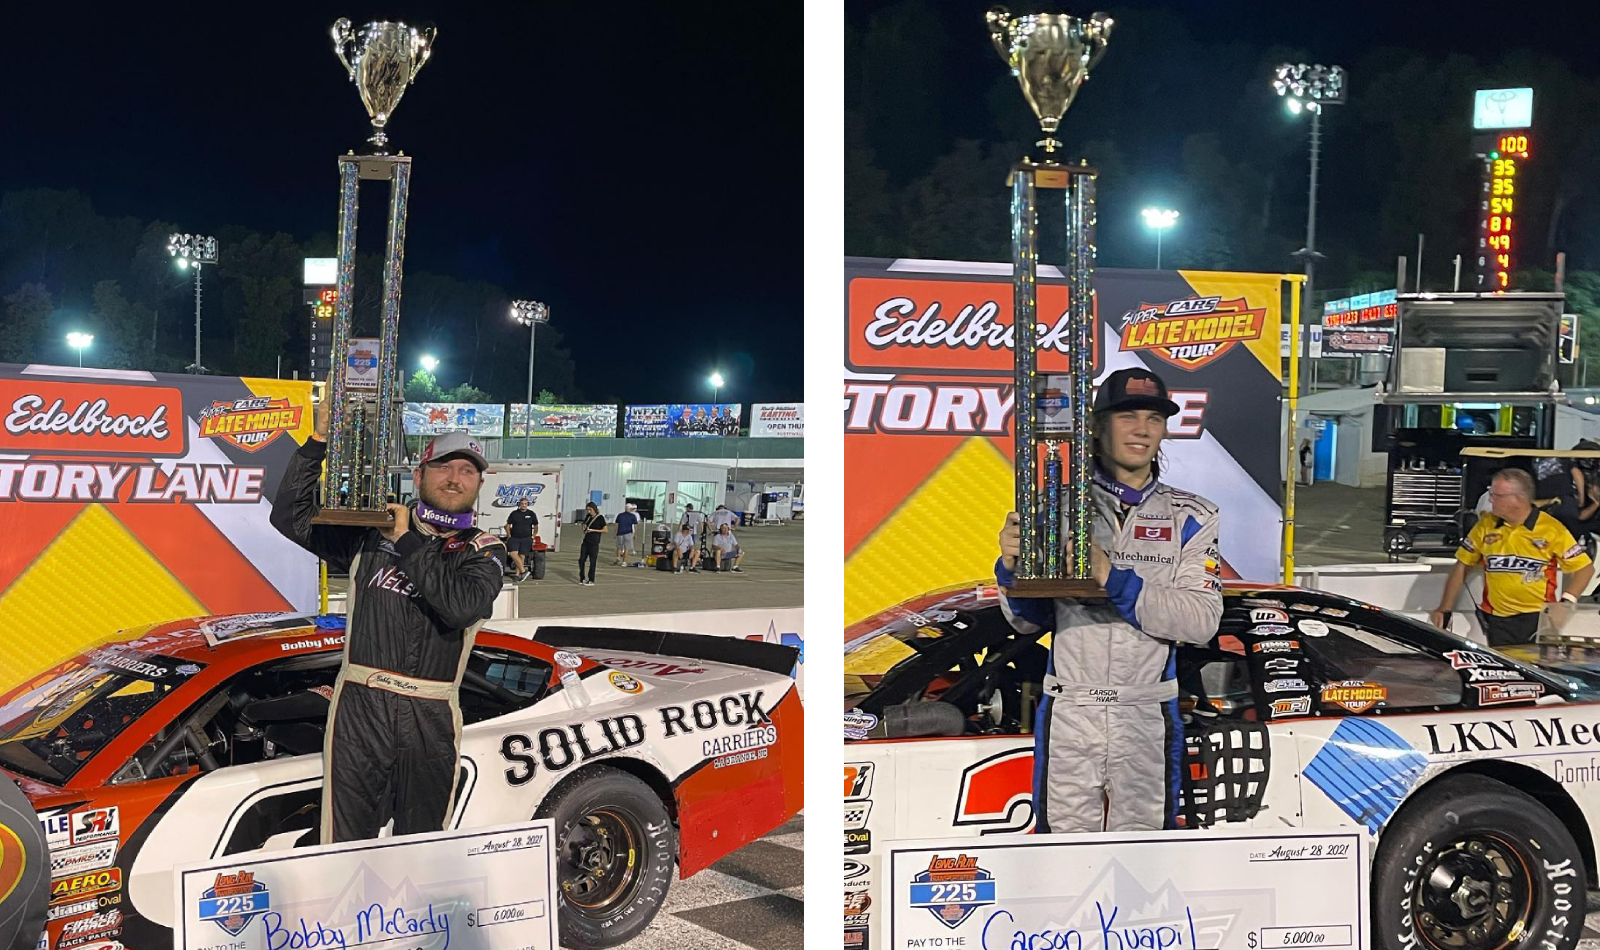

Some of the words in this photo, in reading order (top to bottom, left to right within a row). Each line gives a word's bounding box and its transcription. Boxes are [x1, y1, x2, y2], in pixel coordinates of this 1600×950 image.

[1501, 137, 1527, 153] 100
[1494, 160, 1515, 176] 35
[1493, 179, 1514, 195] 35
[1491, 198, 1513, 214] 54
[1490, 216, 1512, 232] 81
[1489, 235, 1510, 250] 49
[1498, 254, 1509, 268] 4
[1498, 271, 1508, 287] 7
[318, 306, 333, 318] 22
[1119, 307, 1160, 330] SUPER
[1127, 319, 1185, 348] LATE
[1183, 313, 1257, 342] MODEL
[1169, 343, 1216, 360] TOUR
[843, 384, 1014, 432] TORY
[4, 394, 169, 440] Edelbrock
[205, 414, 245, 435] LATE
[245, 410, 297, 431] MODEL
[236, 431, 269, 444] TOUR
[133, 467, 265, 501] LANE
[497, 484, 542, 497] MTP
[422, 508, 458, 525] Hoosier
[1114, 551, 1175, 565] Mechanical
[281, 639, 322, 651] Bobby
[1467, 669, 1521, 681] XTREME
[1089, 688, 1119, 697] CARSON
[1325, 690, 1350, 701] LATE
[1350, 689, 1385, 700] MODEL
[1345, 701, 1366, 709] TOUR
[500, 714, 647, 787] SOLID
[659, 690, 772, 738] ROCK
[702, 727, 776, 757] CARRIERS
[1421, 719, 1518, 755] LKN
[75, 808, 116, 836] SRI
[75, 830, 118, 842] PERFORMANCE
[482, 840, 512, 853] August
[526, 834, 543, 846] 2021
[848, 832, 869, 842] Oval
[1268, 845, 1309, 860] August
[1325, 844, 1350, 856] 2021
[928, 854, 957, 871] LONG
[955, 854, 978, 869] RUN
[53, 872, 111, 894] AERO
[98, 894, 122, 907] Oval
[930, 883, 977, 903] 225
[216, 895, 255, 915] 225
[467, 913, 476, 928] $
[262, 911, 347, 950] Bobby
[982, 910, 1082, 950] Carson
[59, 936, 86, 949] RACE
[88, 929, 119, 941] PARTS
[229, 941, 246, 949] THE
[907, 938, 926, 948] PAY
[928, 937, 943, 947] TO
[945, 936, 967, 946] THE
[1247, 930, 1258, 949] $
